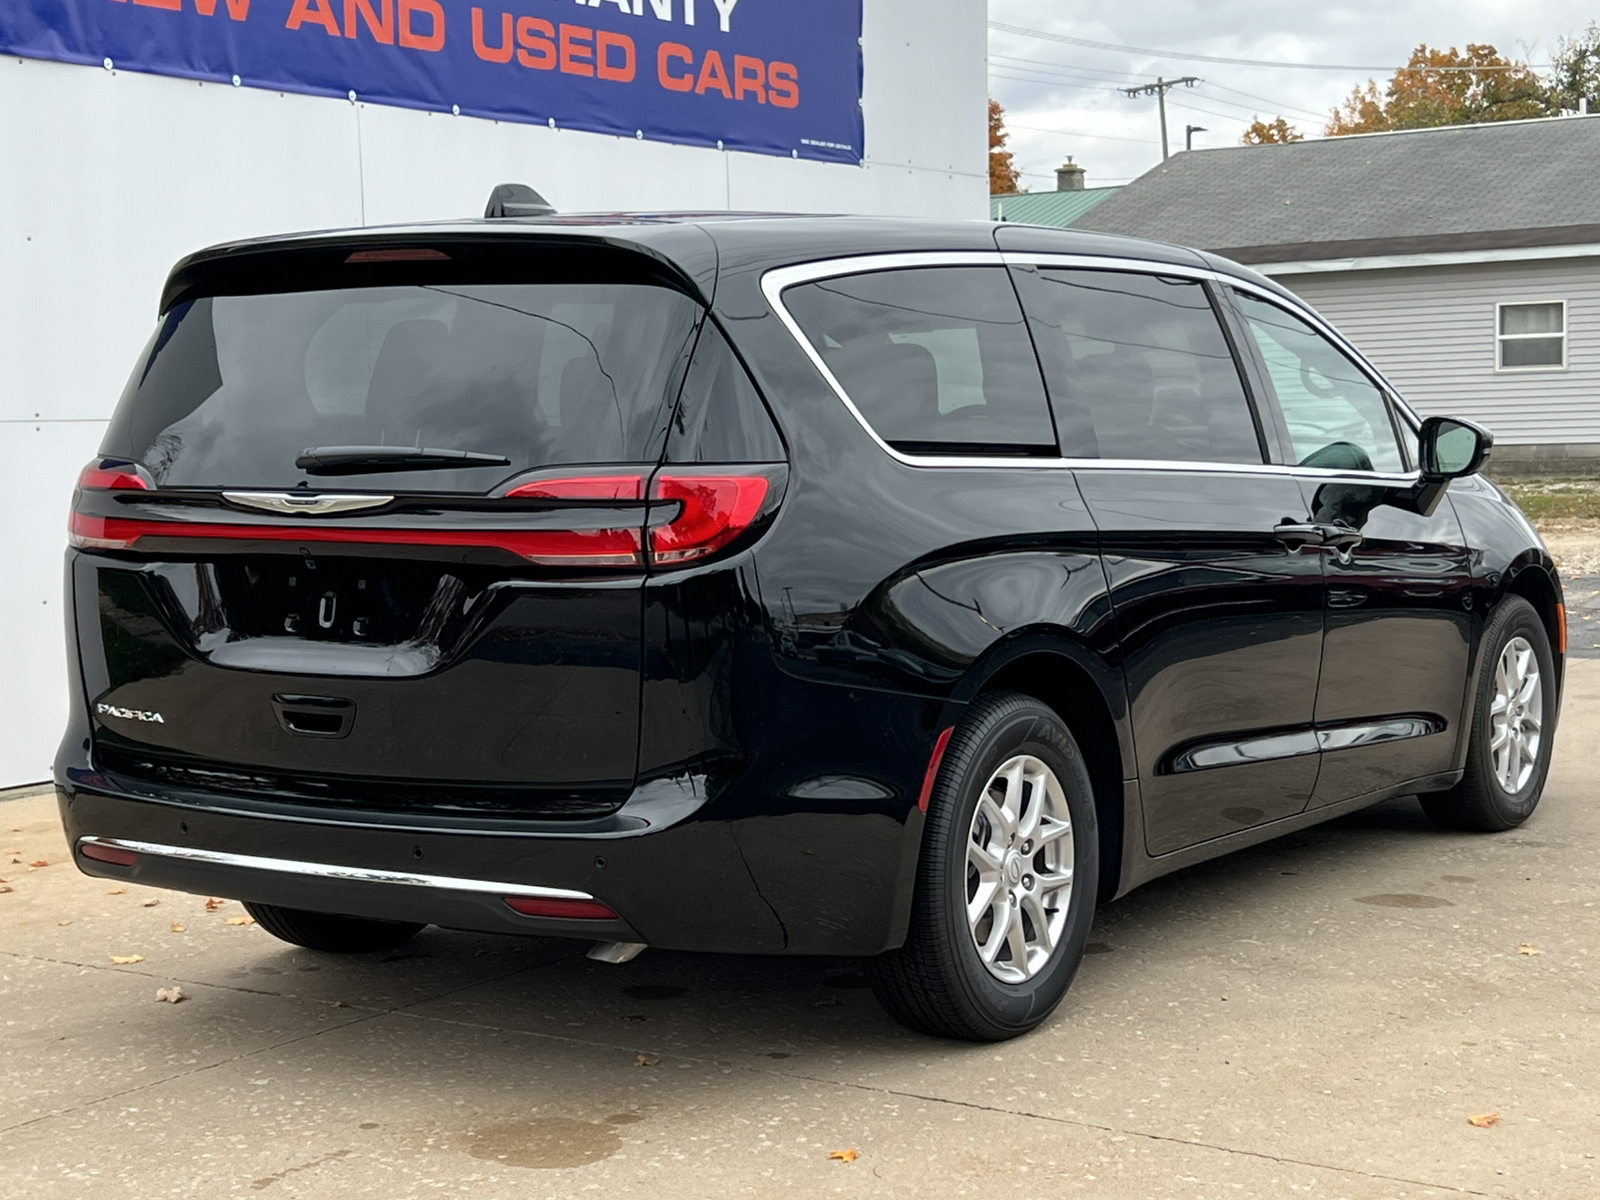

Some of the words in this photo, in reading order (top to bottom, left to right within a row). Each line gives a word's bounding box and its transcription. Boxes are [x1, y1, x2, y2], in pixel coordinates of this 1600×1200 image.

[285, 0, 446, 52] AND
[472, 7, 636, 83] USED
[657, 41, 799, 109] CARS
[97, 703, 164, 723] PACIFICA
